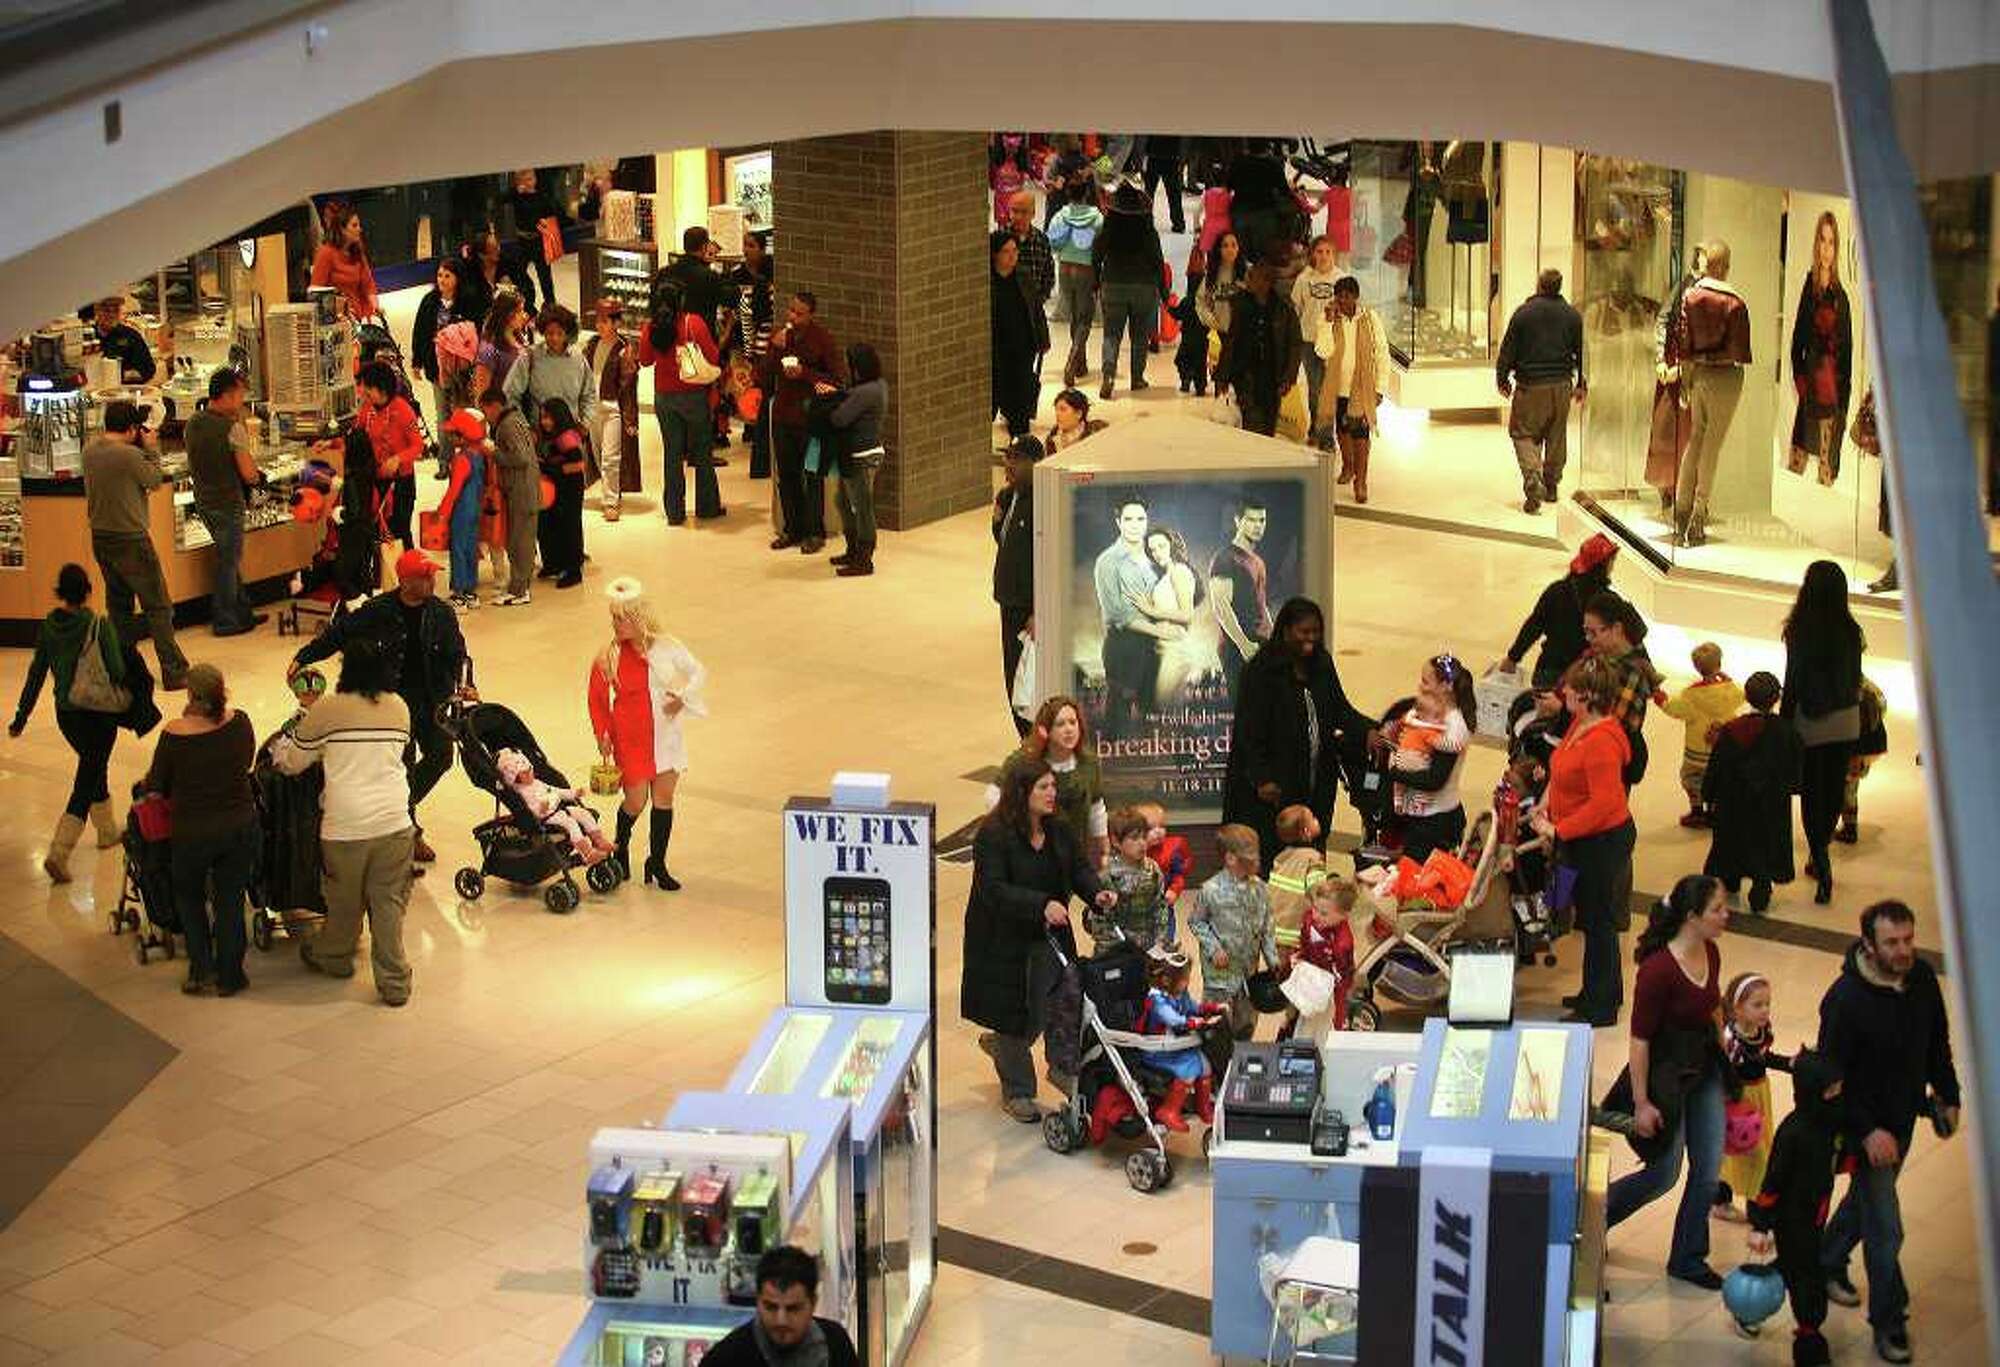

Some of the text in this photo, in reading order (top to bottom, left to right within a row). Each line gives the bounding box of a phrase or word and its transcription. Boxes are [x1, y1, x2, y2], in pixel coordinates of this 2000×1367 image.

[1096, 728, 1211, 761] breaking
[794, 814, 919, 846] WE FIX
[836, 845, 879, 873] IT.
[672, 1279, 691, 1304] IT
[1431, 1197, 1472, 1367] TALK
